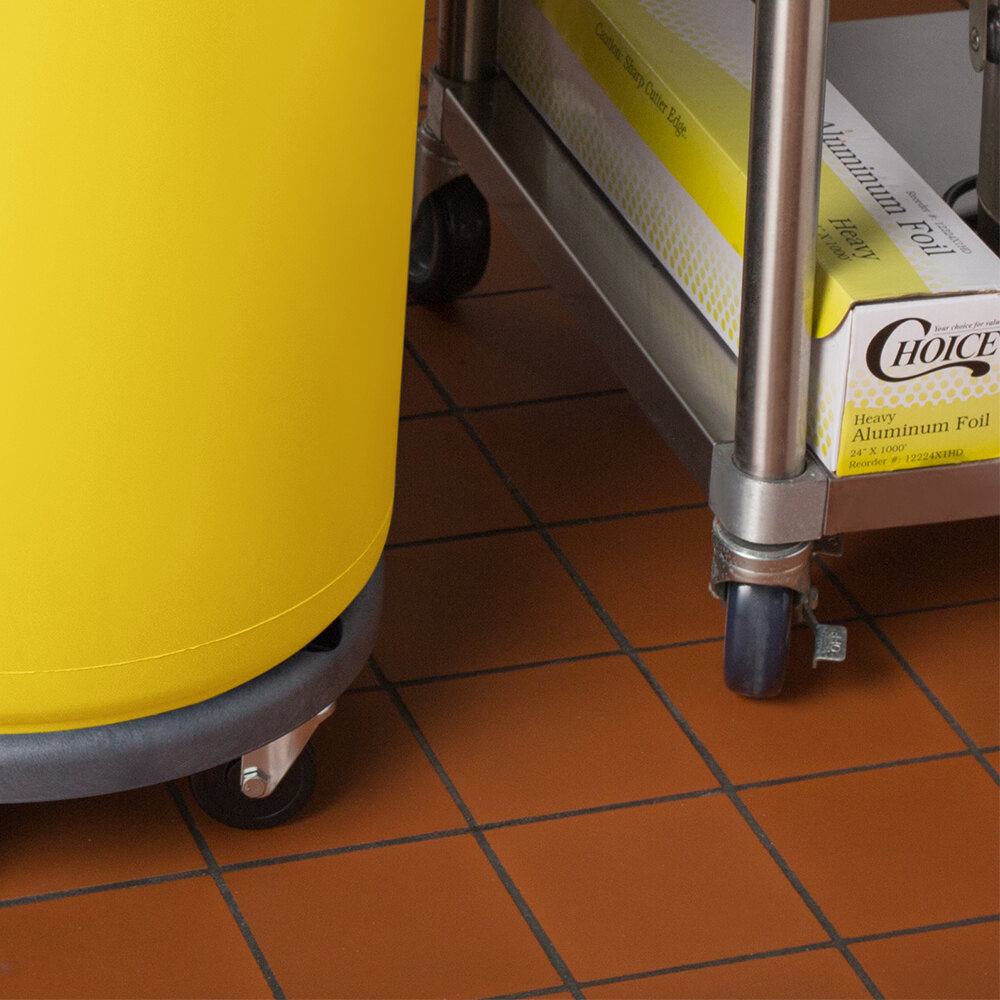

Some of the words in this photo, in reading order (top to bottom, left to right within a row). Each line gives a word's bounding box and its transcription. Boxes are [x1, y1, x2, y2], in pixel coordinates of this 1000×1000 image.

[623, 54, 645, 89] Sharp
[645, 80, 669, 114] Cutter
[828, 217, 881, 261] Heavy
[896, 219, 957, 257] Foil
[950, 322, 973, 331] choice
[973, 320, 984, 329] for
[865, 317, 1000, 382] CHOICE
[851, 420, 949, 442] Aluminum
[955, 413, 991, 431] Foil
[854, 412, 896, 426] Heavy
[848, 457, 887, 469] Reorder
[905, 448, 965, 463] 12224X1HD
[868, 446, 877, 456] X
